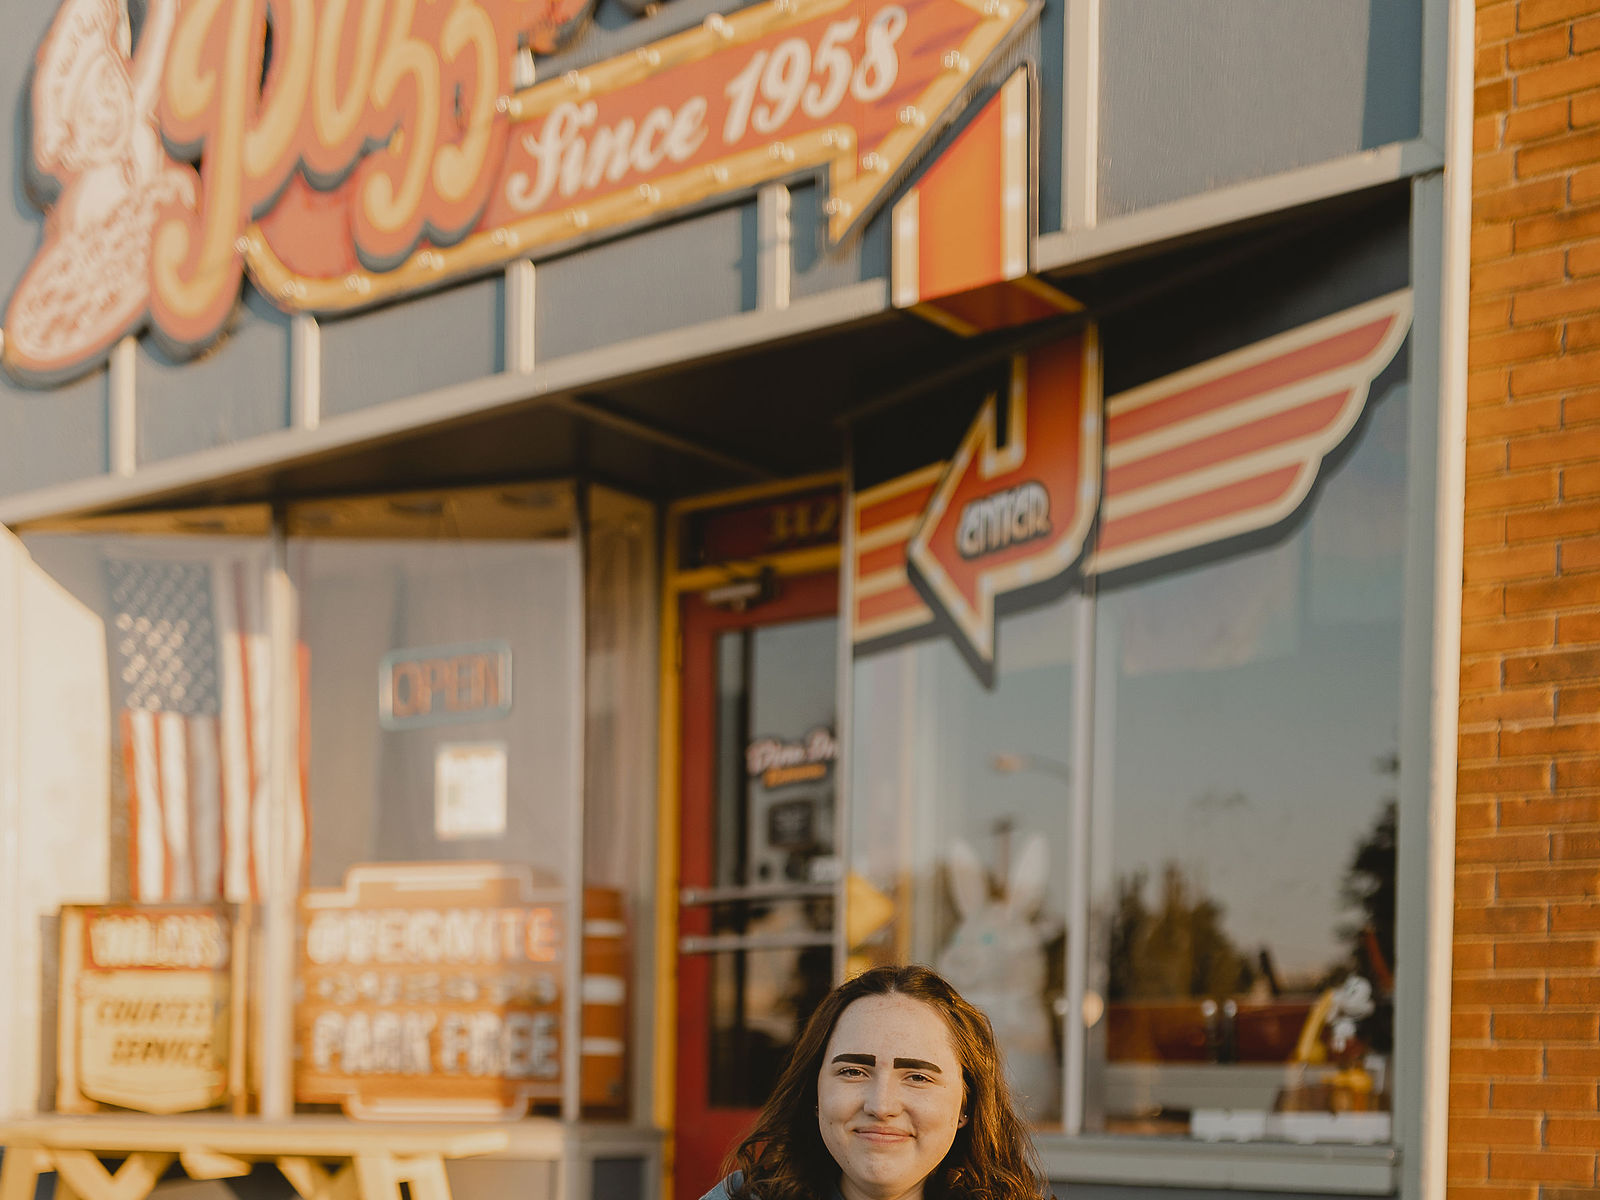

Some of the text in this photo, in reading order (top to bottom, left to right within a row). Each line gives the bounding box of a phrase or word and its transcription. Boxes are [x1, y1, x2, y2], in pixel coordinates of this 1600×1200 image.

[505, 6, 908, 212] Since 1958
[391, 651, 500, 718] OPEN
[312, 1009, 559, 1079] PARK FREE
